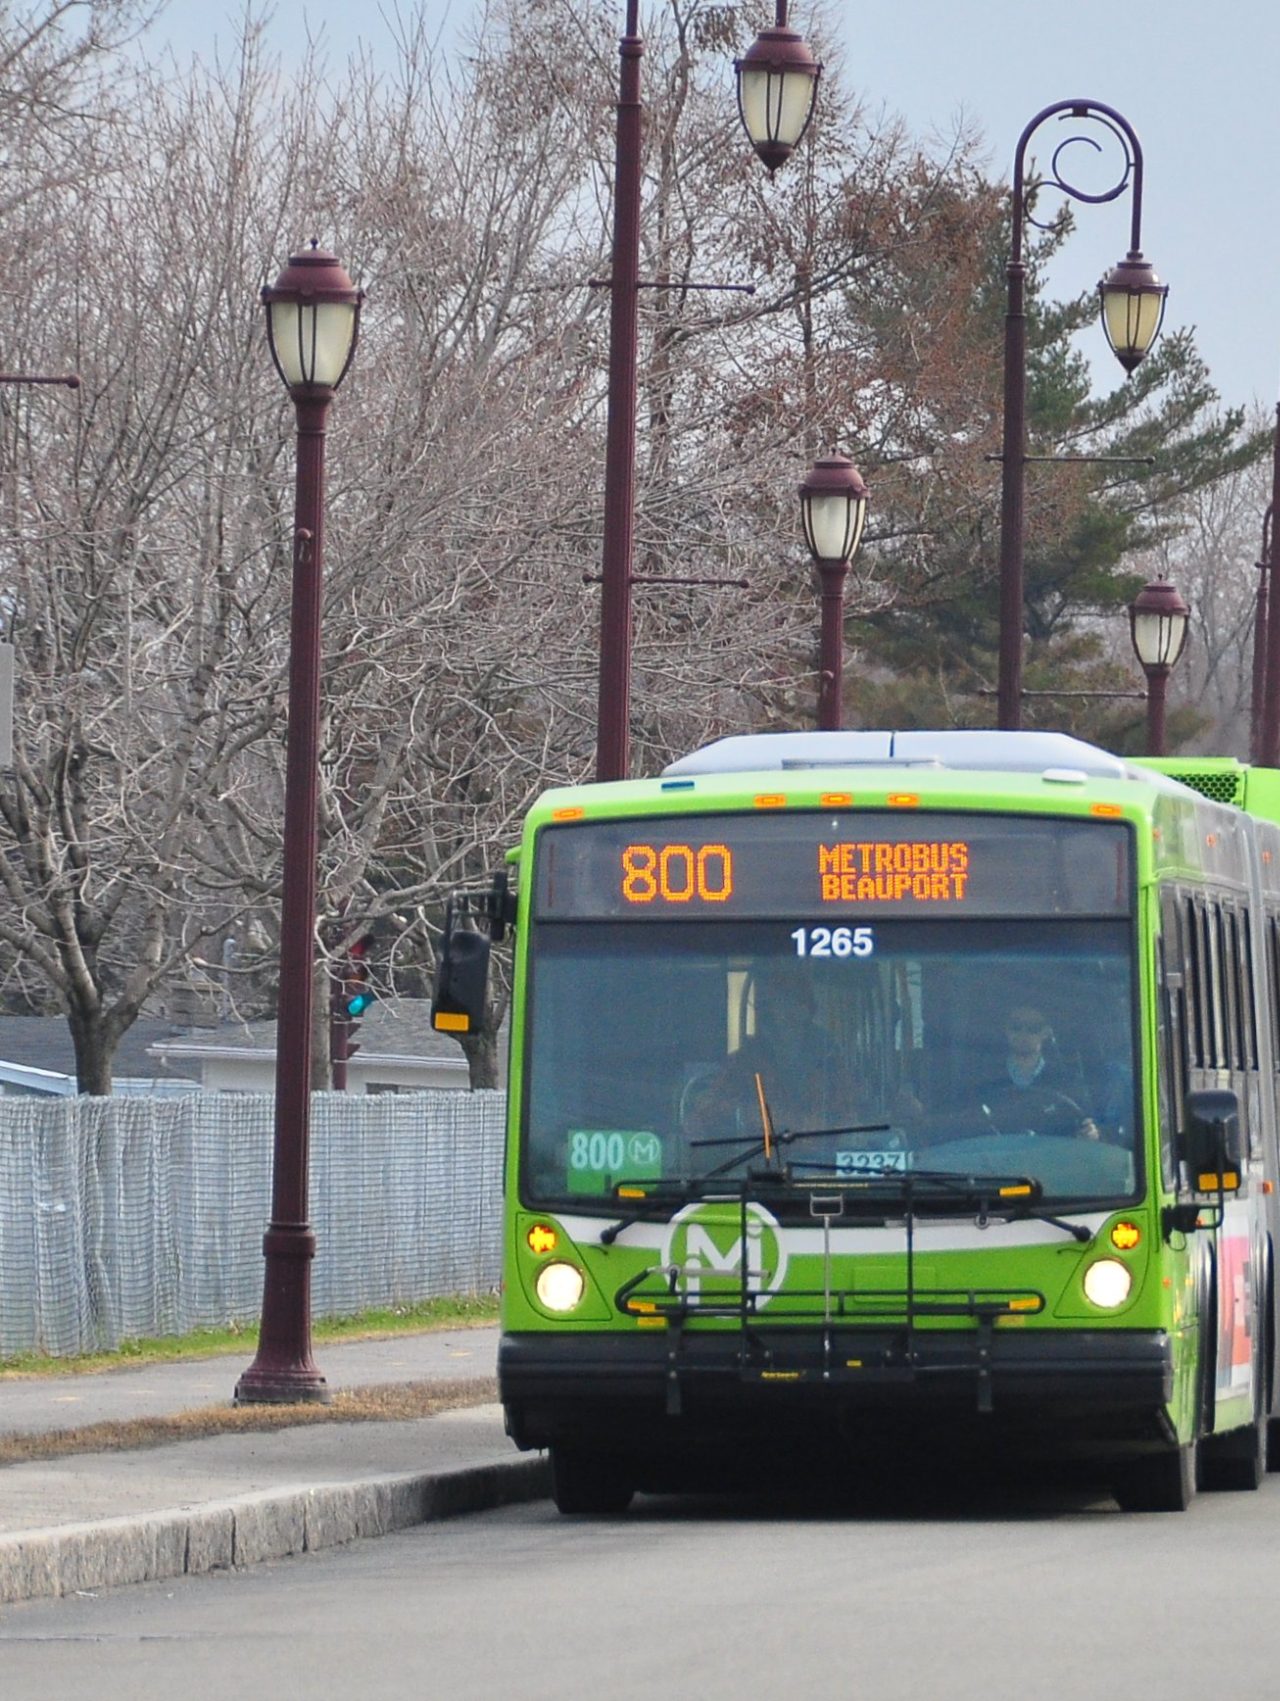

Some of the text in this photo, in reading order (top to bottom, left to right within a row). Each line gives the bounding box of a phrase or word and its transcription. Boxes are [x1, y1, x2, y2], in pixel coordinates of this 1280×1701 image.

[622, 844, 733, 903] 800
[818, 842, 969, 874] METROBUS
[821, 873, 969, 901] BEAUPORT
[791, 927, 875, 957] 1265
[571, 1132, 624, 1170] 800
